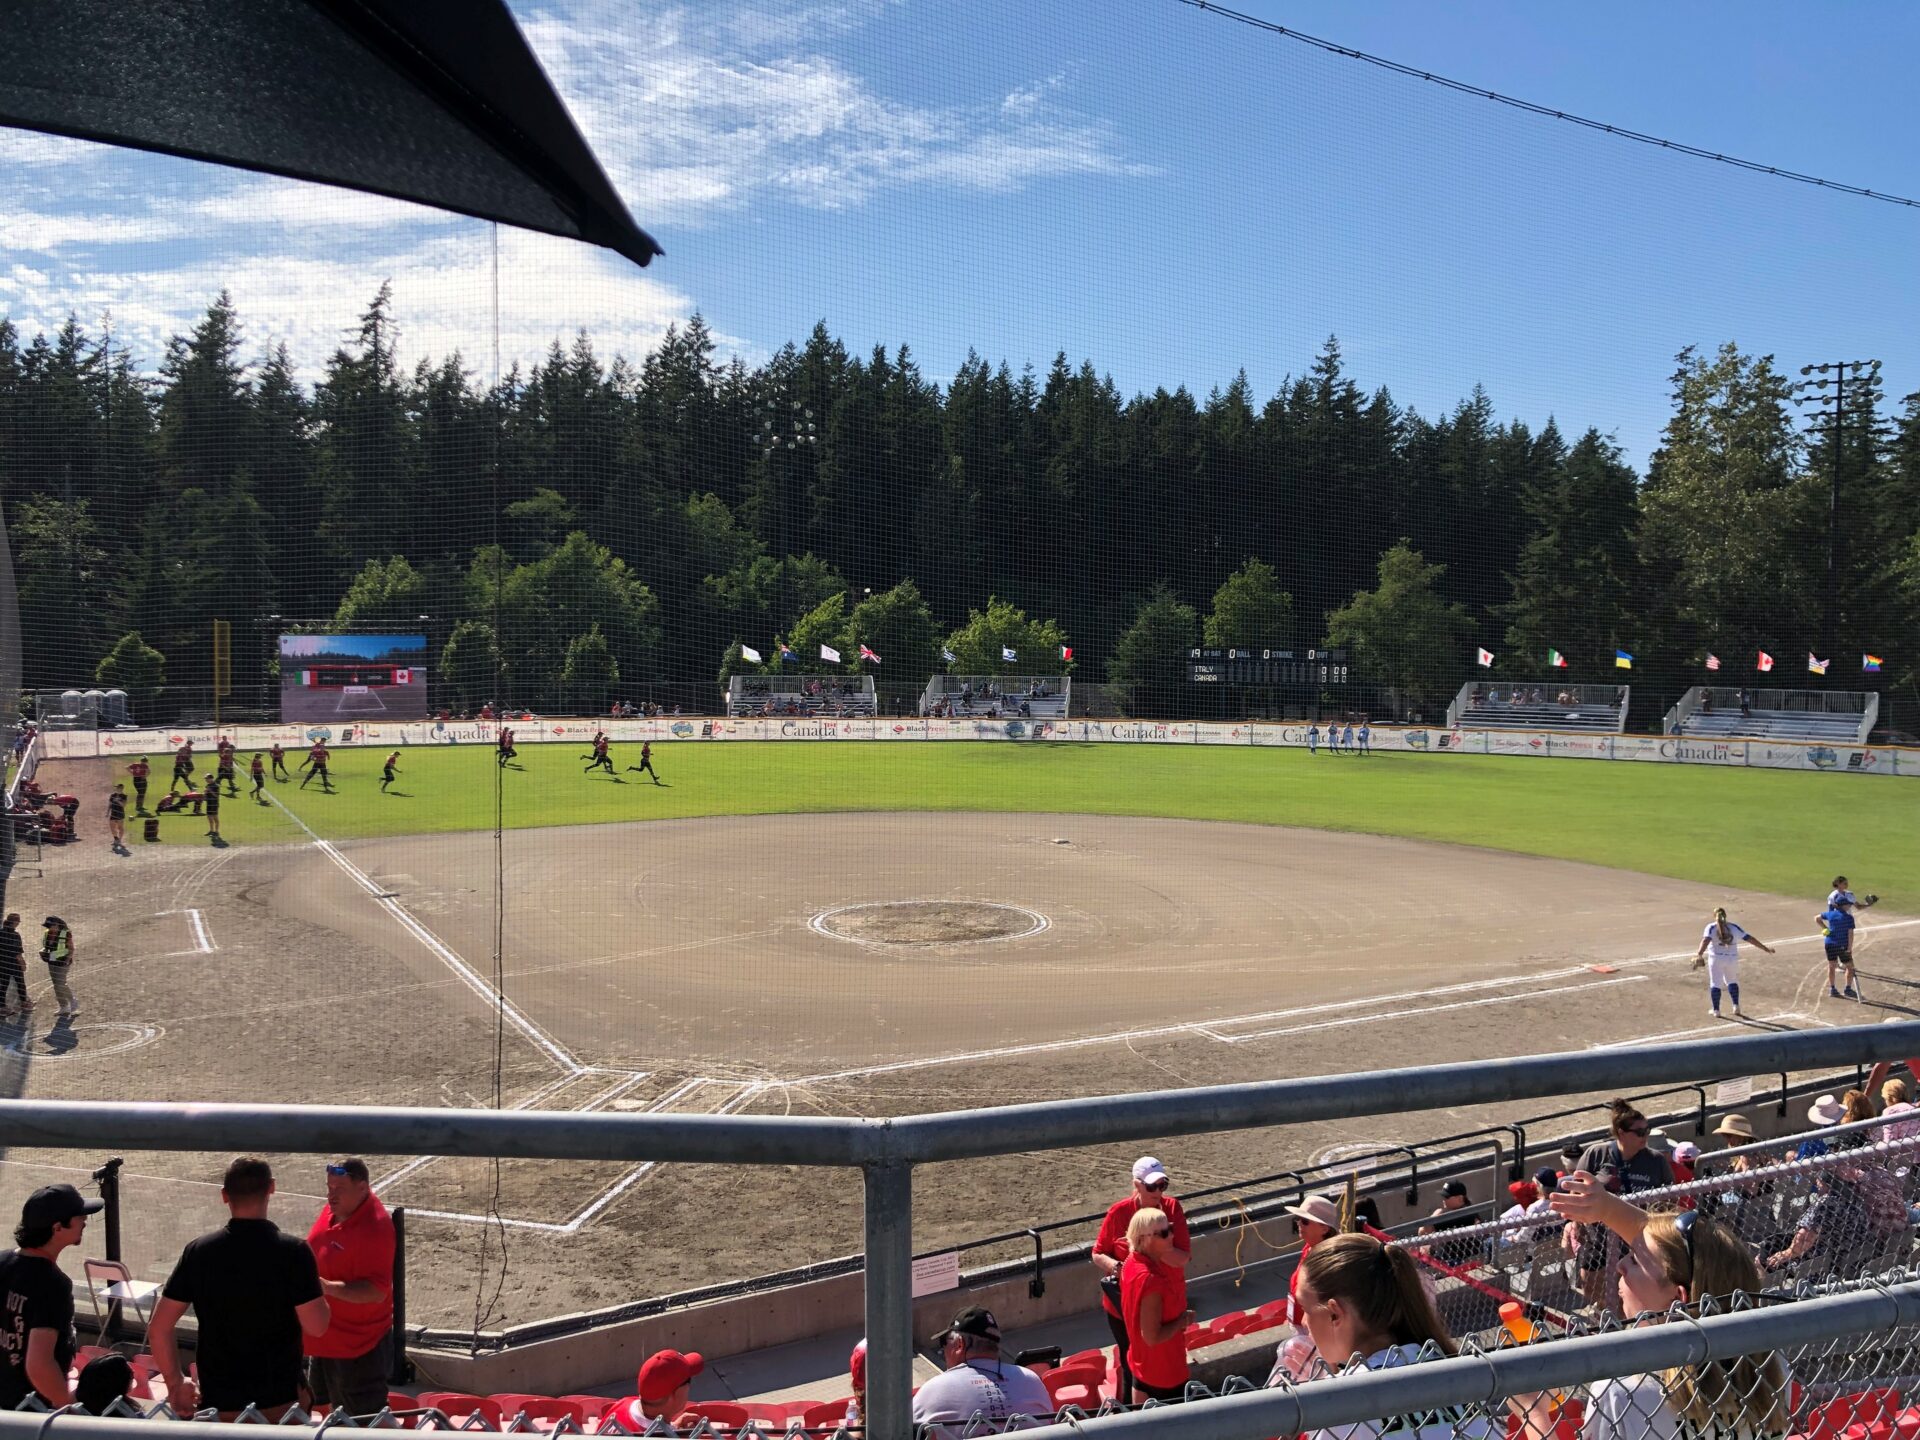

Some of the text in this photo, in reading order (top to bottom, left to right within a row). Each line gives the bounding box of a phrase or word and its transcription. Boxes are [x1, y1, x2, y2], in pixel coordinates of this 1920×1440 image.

[1192, 649, 1200, 658] 19
[1229, 649, 1235, 658] 0
[1264, 649, 1270, 659] 0
[1309, 650, 1315, 659] 0
[430, 723, 490, 740] Canada
[782, 722, 836, 737] Canada
[1112, 725, 1166, 739] Canada
[1660, 742, 1727, 760] Canada
